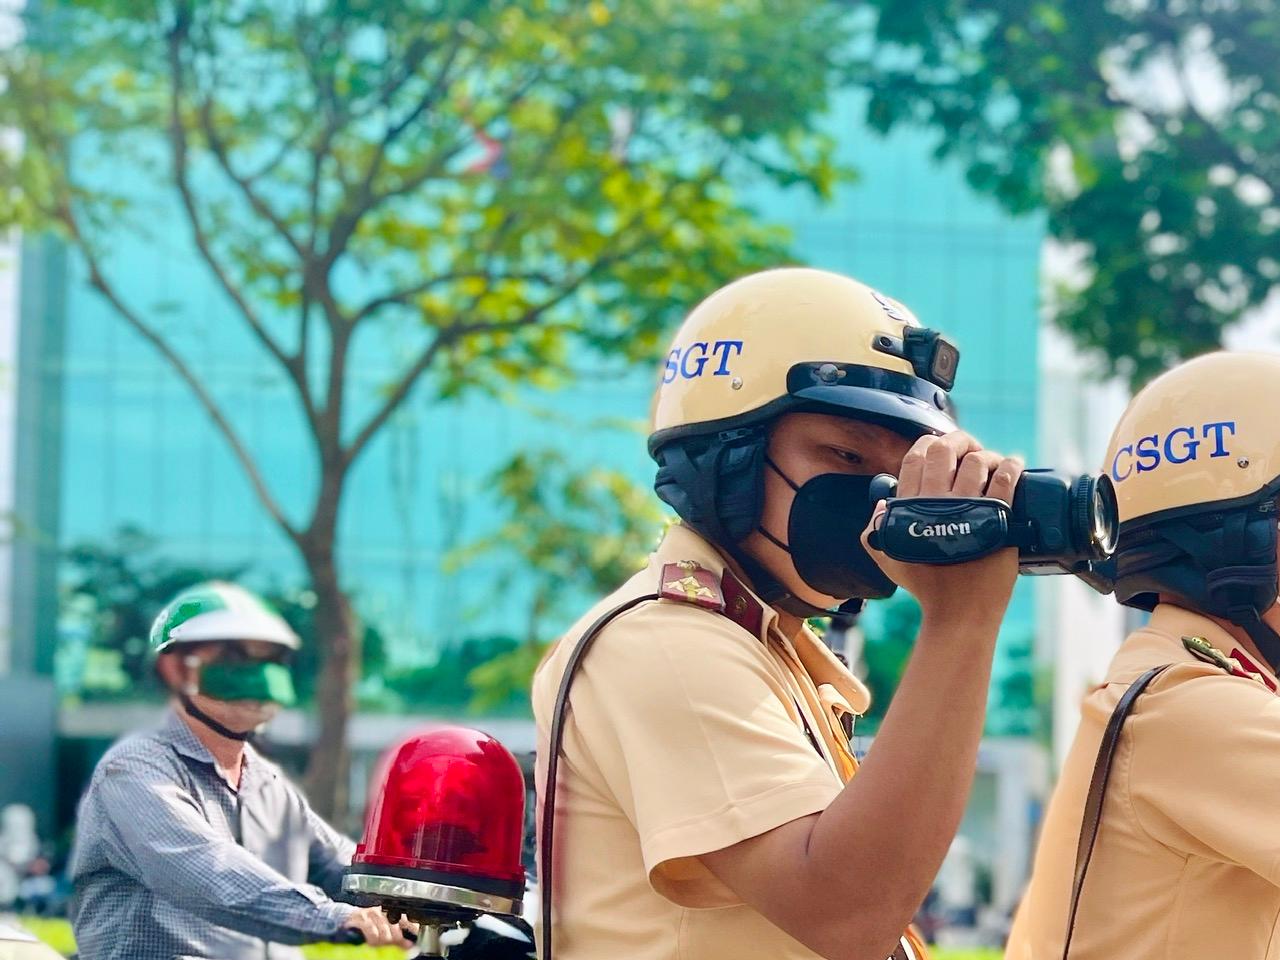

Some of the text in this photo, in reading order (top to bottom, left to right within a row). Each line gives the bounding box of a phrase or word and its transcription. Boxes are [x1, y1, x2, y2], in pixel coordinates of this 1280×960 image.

[662, 340, 744, 385] SGT
[1111, 421, 1236, 483] CSGT
[907, 521, 972, 538] Canon
